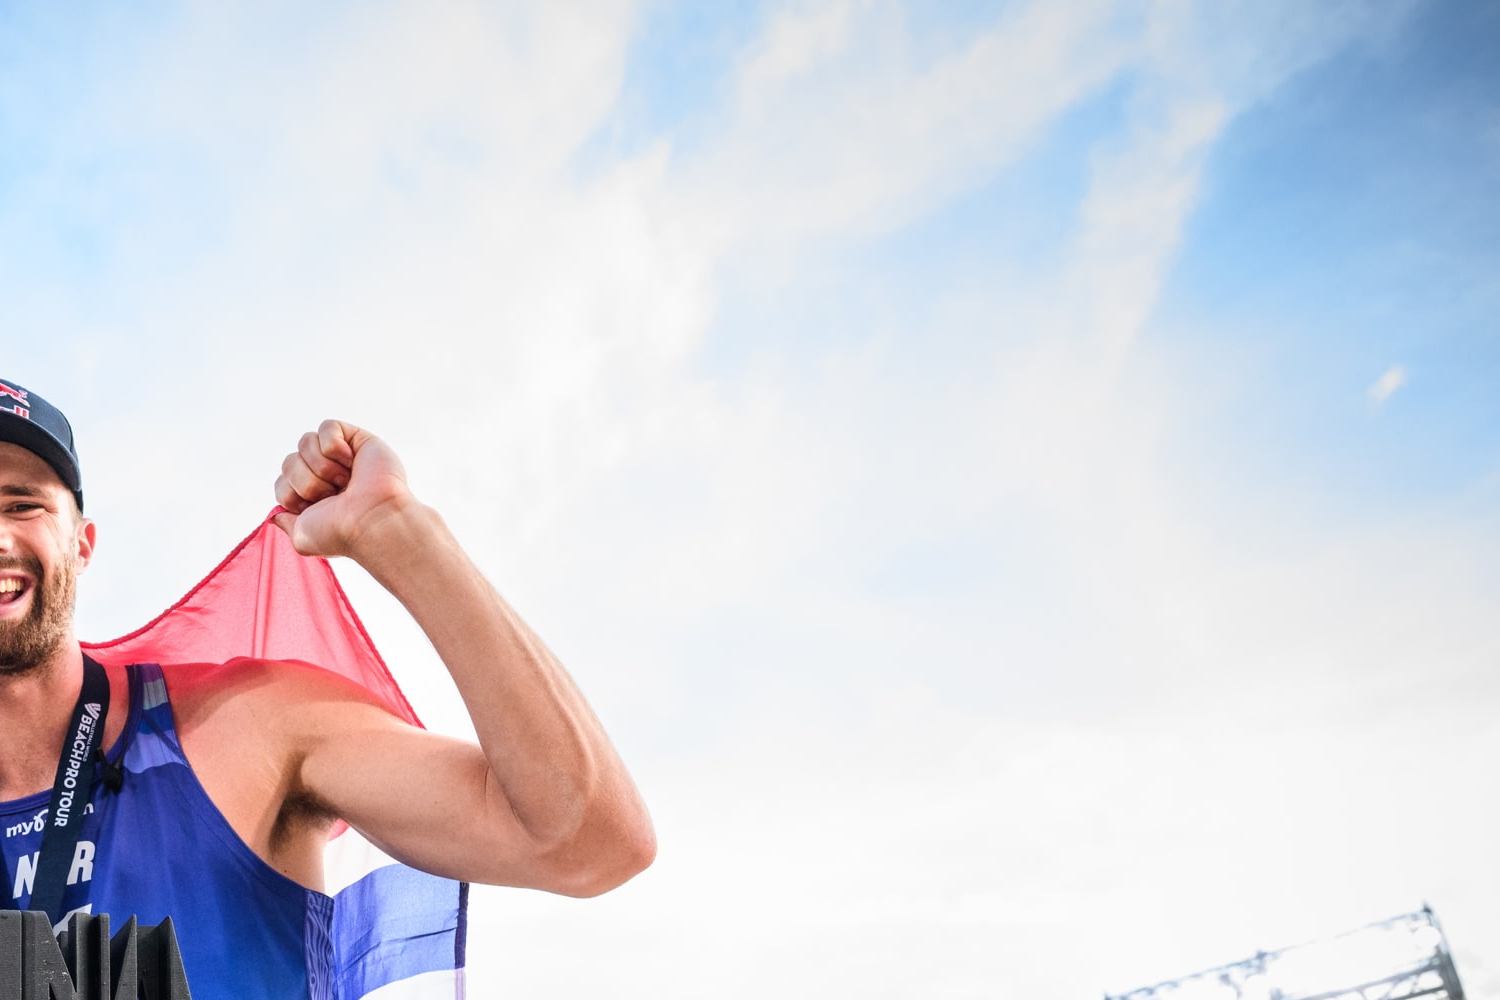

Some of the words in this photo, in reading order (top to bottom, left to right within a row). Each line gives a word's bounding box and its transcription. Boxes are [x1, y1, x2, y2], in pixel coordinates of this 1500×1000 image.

[71, 714, 93, 761] BEACH
[64, 759, 81, 789] PRO
[54, 790, 74, 828] TOUR
[13, 841, 96, 899] NR
